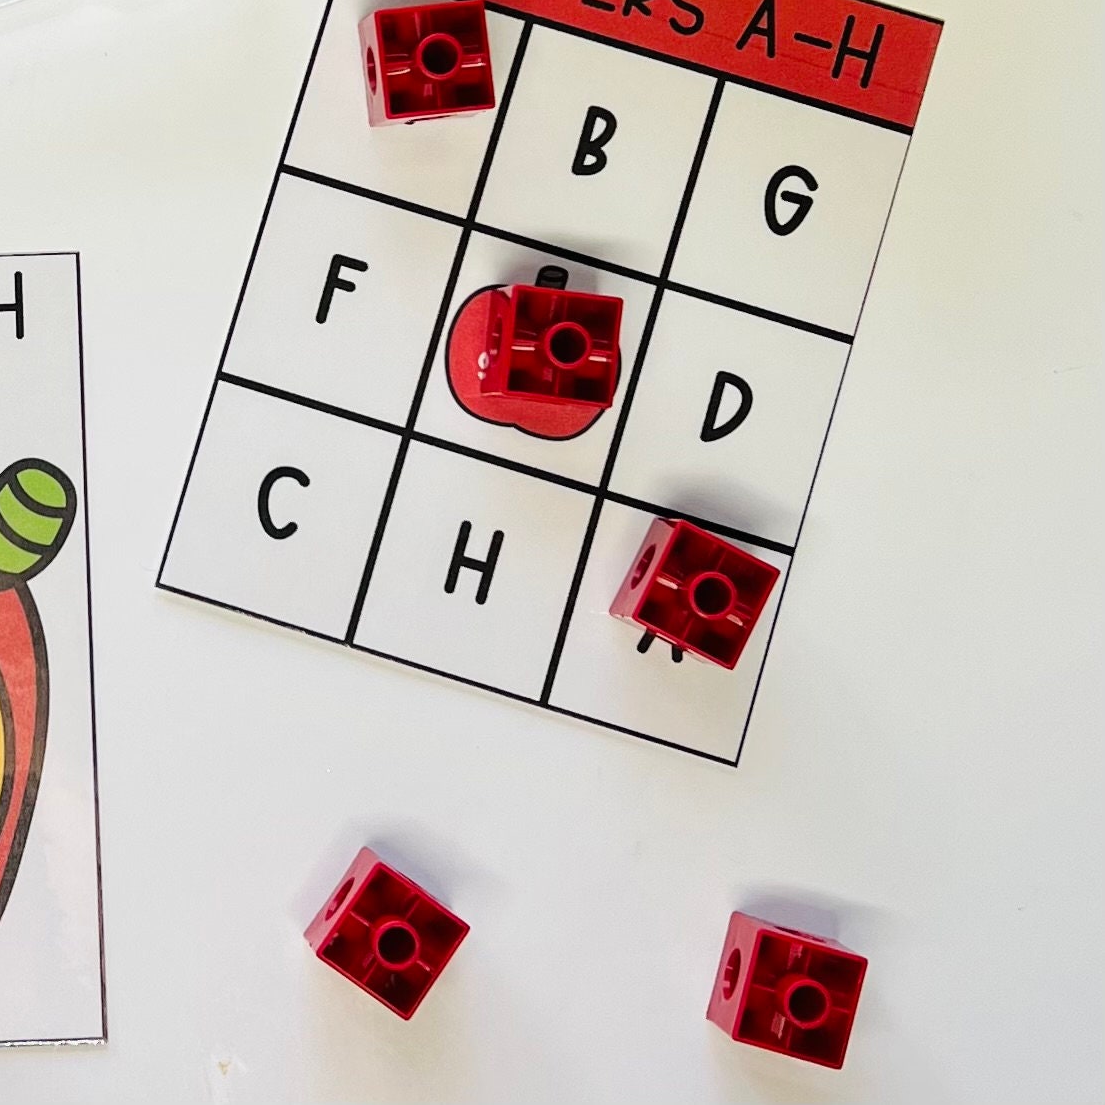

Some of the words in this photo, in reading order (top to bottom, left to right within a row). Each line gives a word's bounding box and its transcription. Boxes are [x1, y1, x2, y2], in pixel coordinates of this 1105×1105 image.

[571, 105, 618, 176] B
[764, 164, 819, 237] G
[315, 253, 369, 325] F
[699, 370, 754, 443] D
[257, 466, 311, 540] C
[444, 520, 505, 605] H
